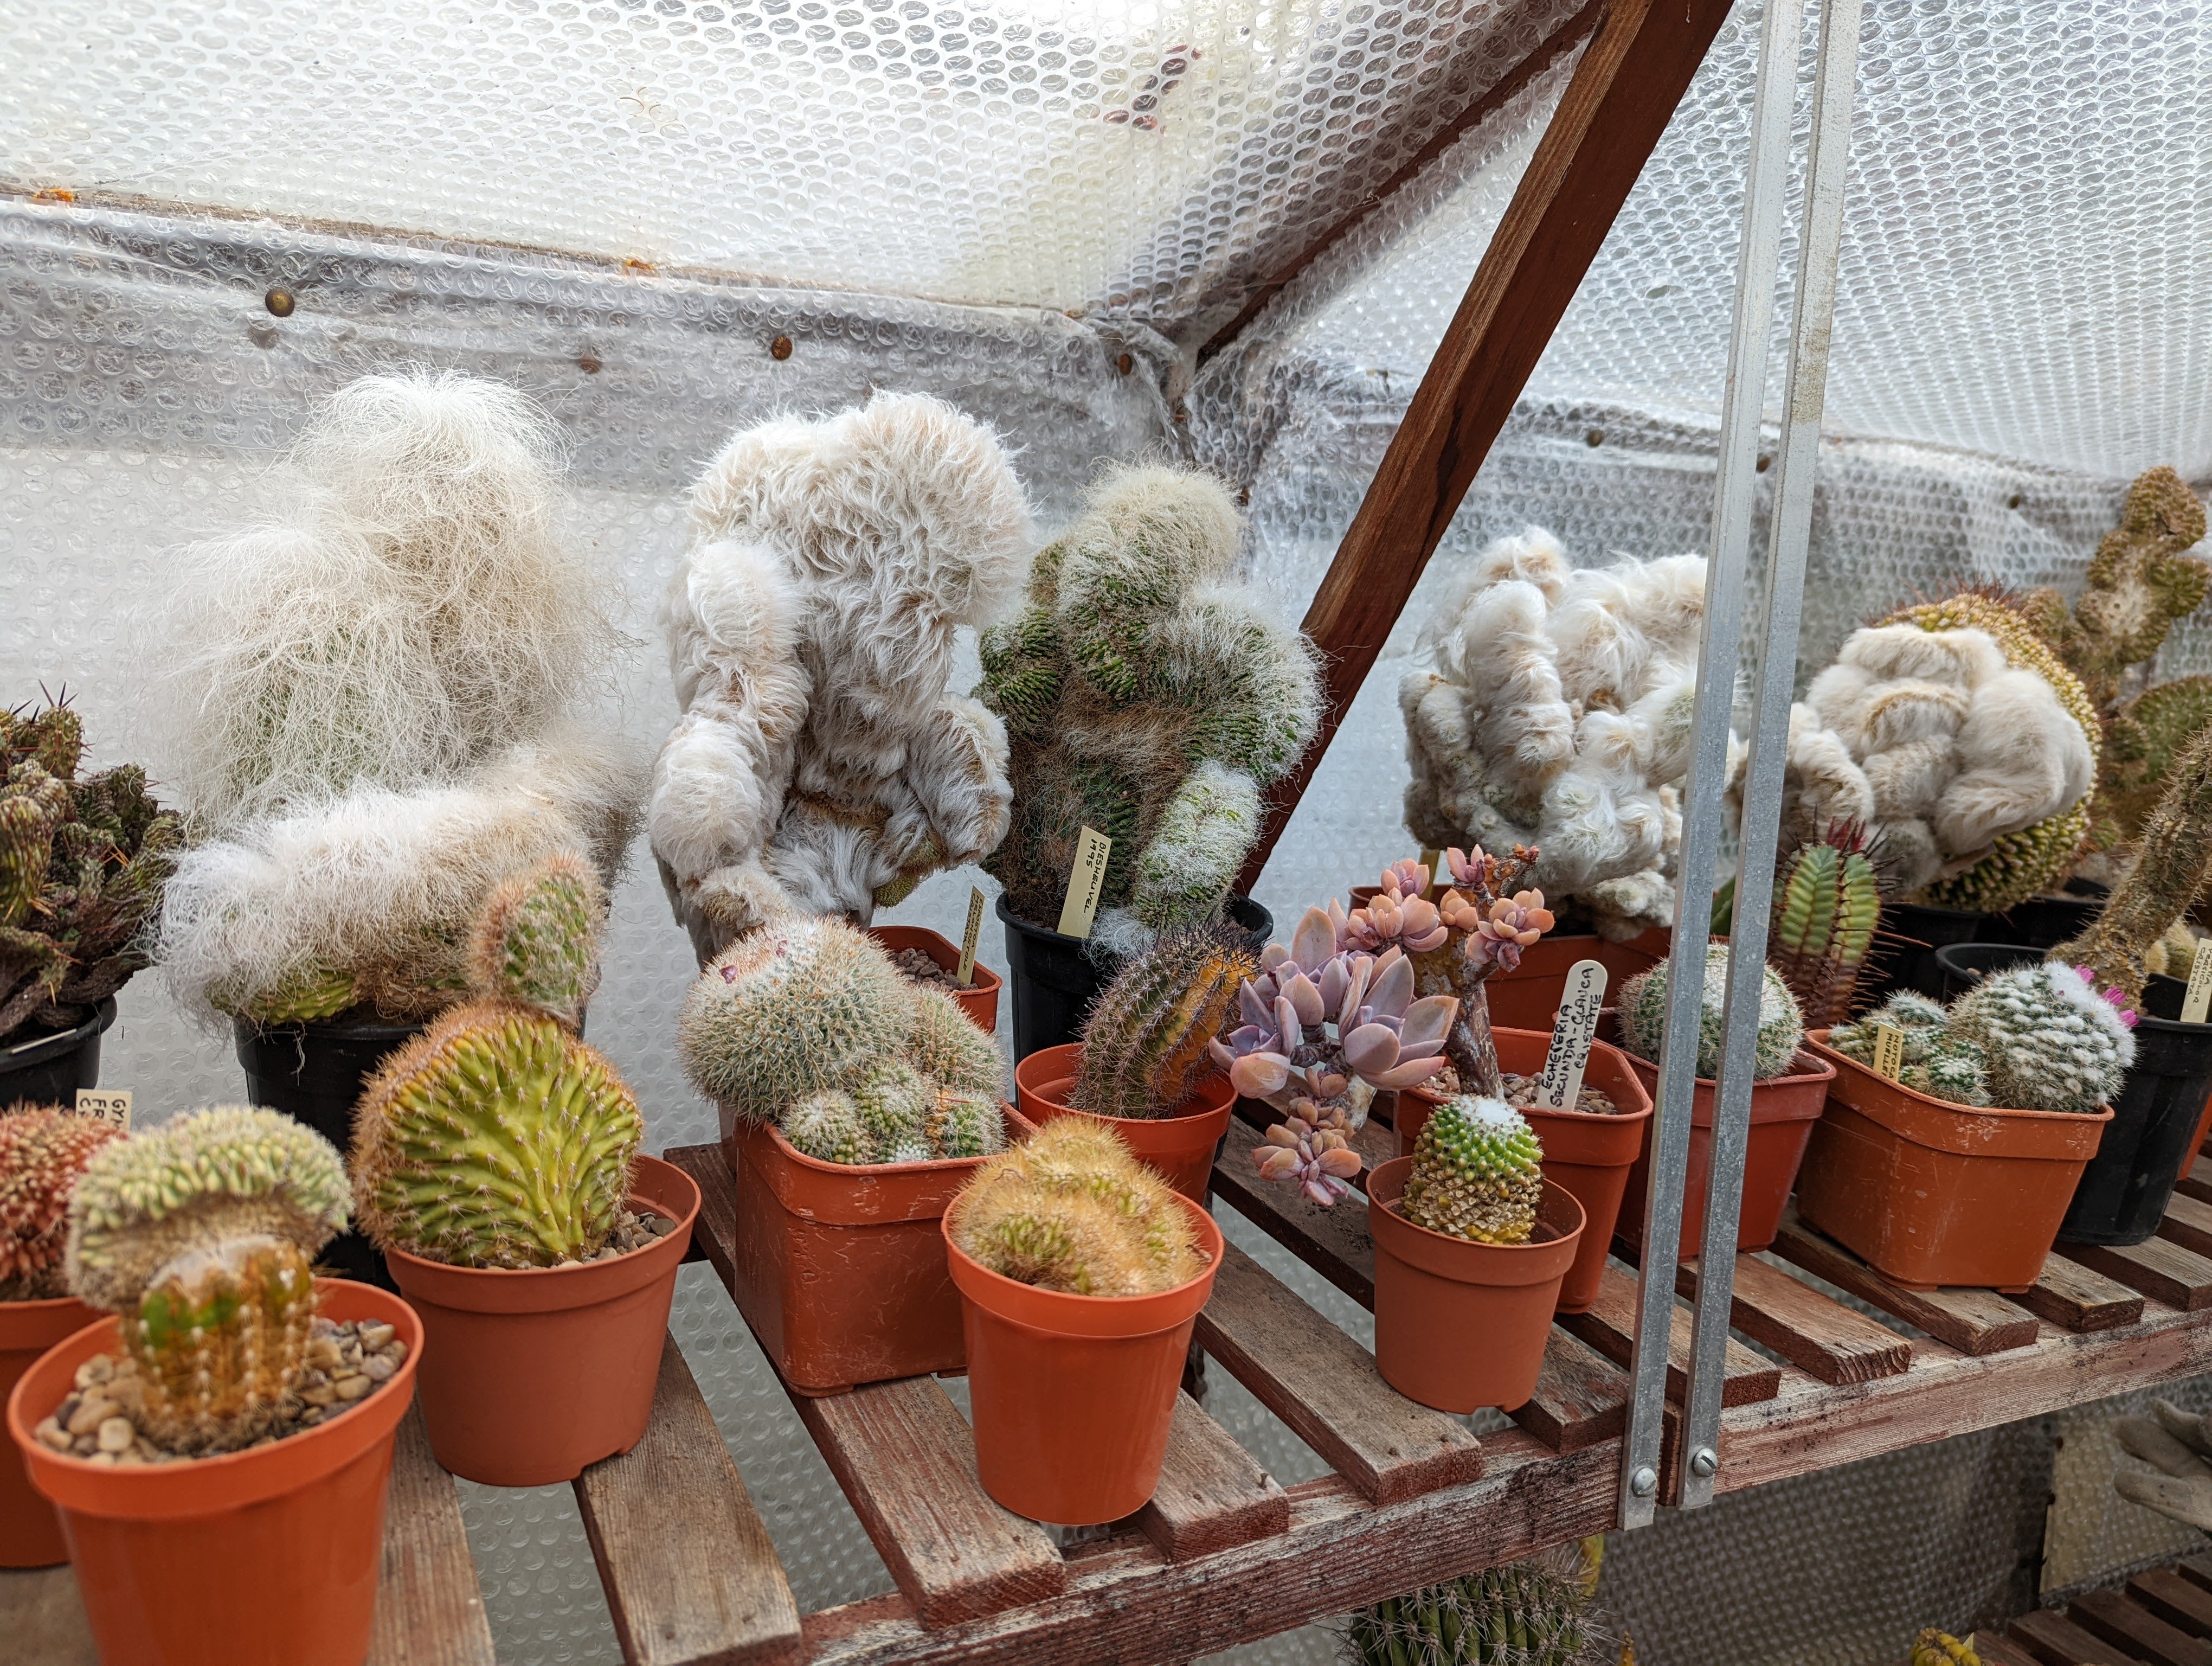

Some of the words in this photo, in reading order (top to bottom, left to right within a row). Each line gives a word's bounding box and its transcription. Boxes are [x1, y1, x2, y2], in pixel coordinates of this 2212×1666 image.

[1084, 842, 1107, 913] BIESHEUVEL
[1086, 838, 1098, 868] 1995
[971, 898, 983, 948] ESPOSTOA
[2188, 946, 2206, 995] CRISTATA
[1573, 994, 1602, 1069] CRISTATE
